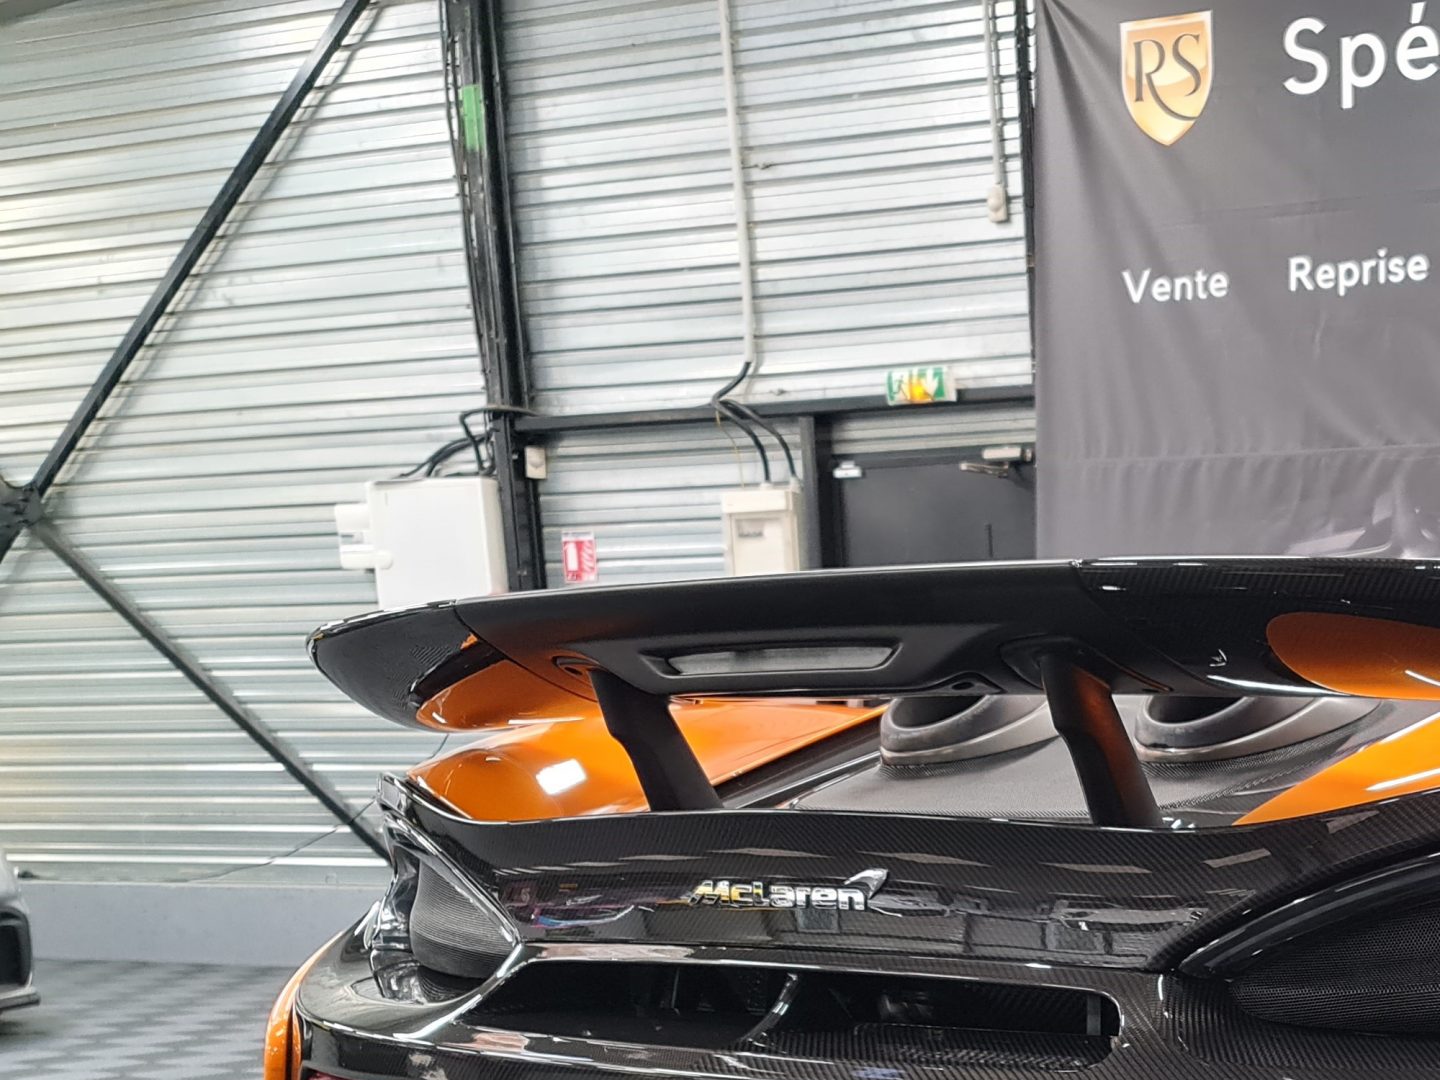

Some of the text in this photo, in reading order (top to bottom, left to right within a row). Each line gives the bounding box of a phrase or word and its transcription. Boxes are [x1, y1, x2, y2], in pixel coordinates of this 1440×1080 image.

[1133, 33, 1201, 121] RS
[1122, 267, 1229, 305] Vente
[1288, 248, 1429, 297] Reprise
[688, 880, 865, 911] McLaren
